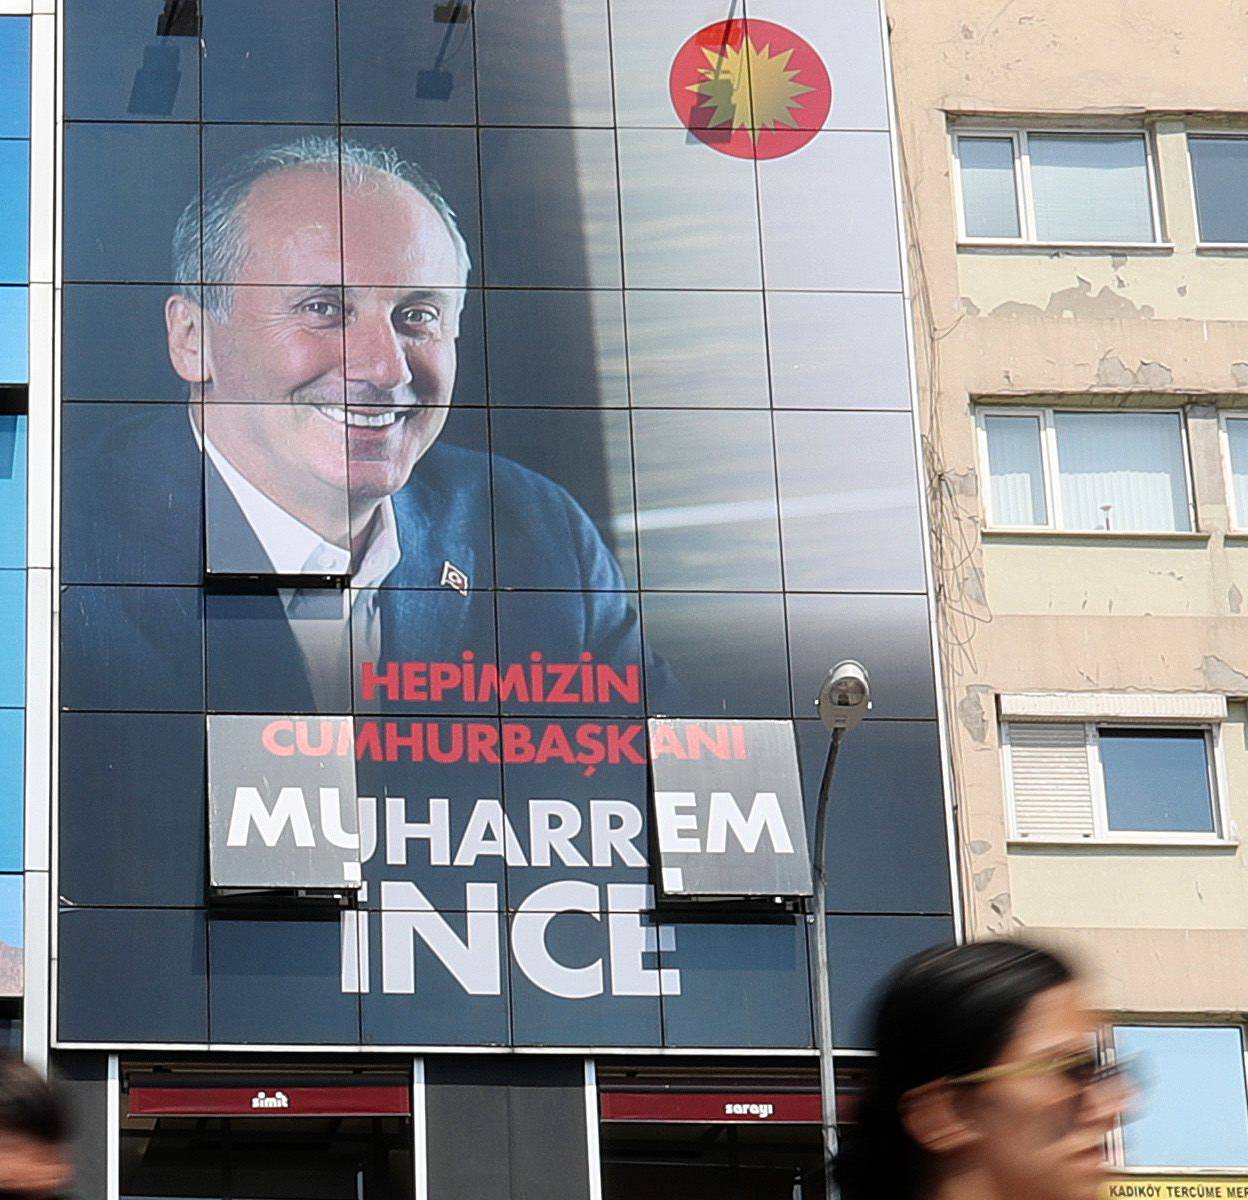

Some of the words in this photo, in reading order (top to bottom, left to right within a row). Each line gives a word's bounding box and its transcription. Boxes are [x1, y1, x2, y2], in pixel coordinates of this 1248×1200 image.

[360, 650, 640, 704] HEPİMİZİN
[261, 719, 746, 777] CUMHURBAŞKANI
[226, 786, 795, 868] MUHARREM
[341, 872, 680, 998] İNCE
[252, 1091, 288, 1108] simit
[1166, 1184, 1222, 1198] TERCÜME
